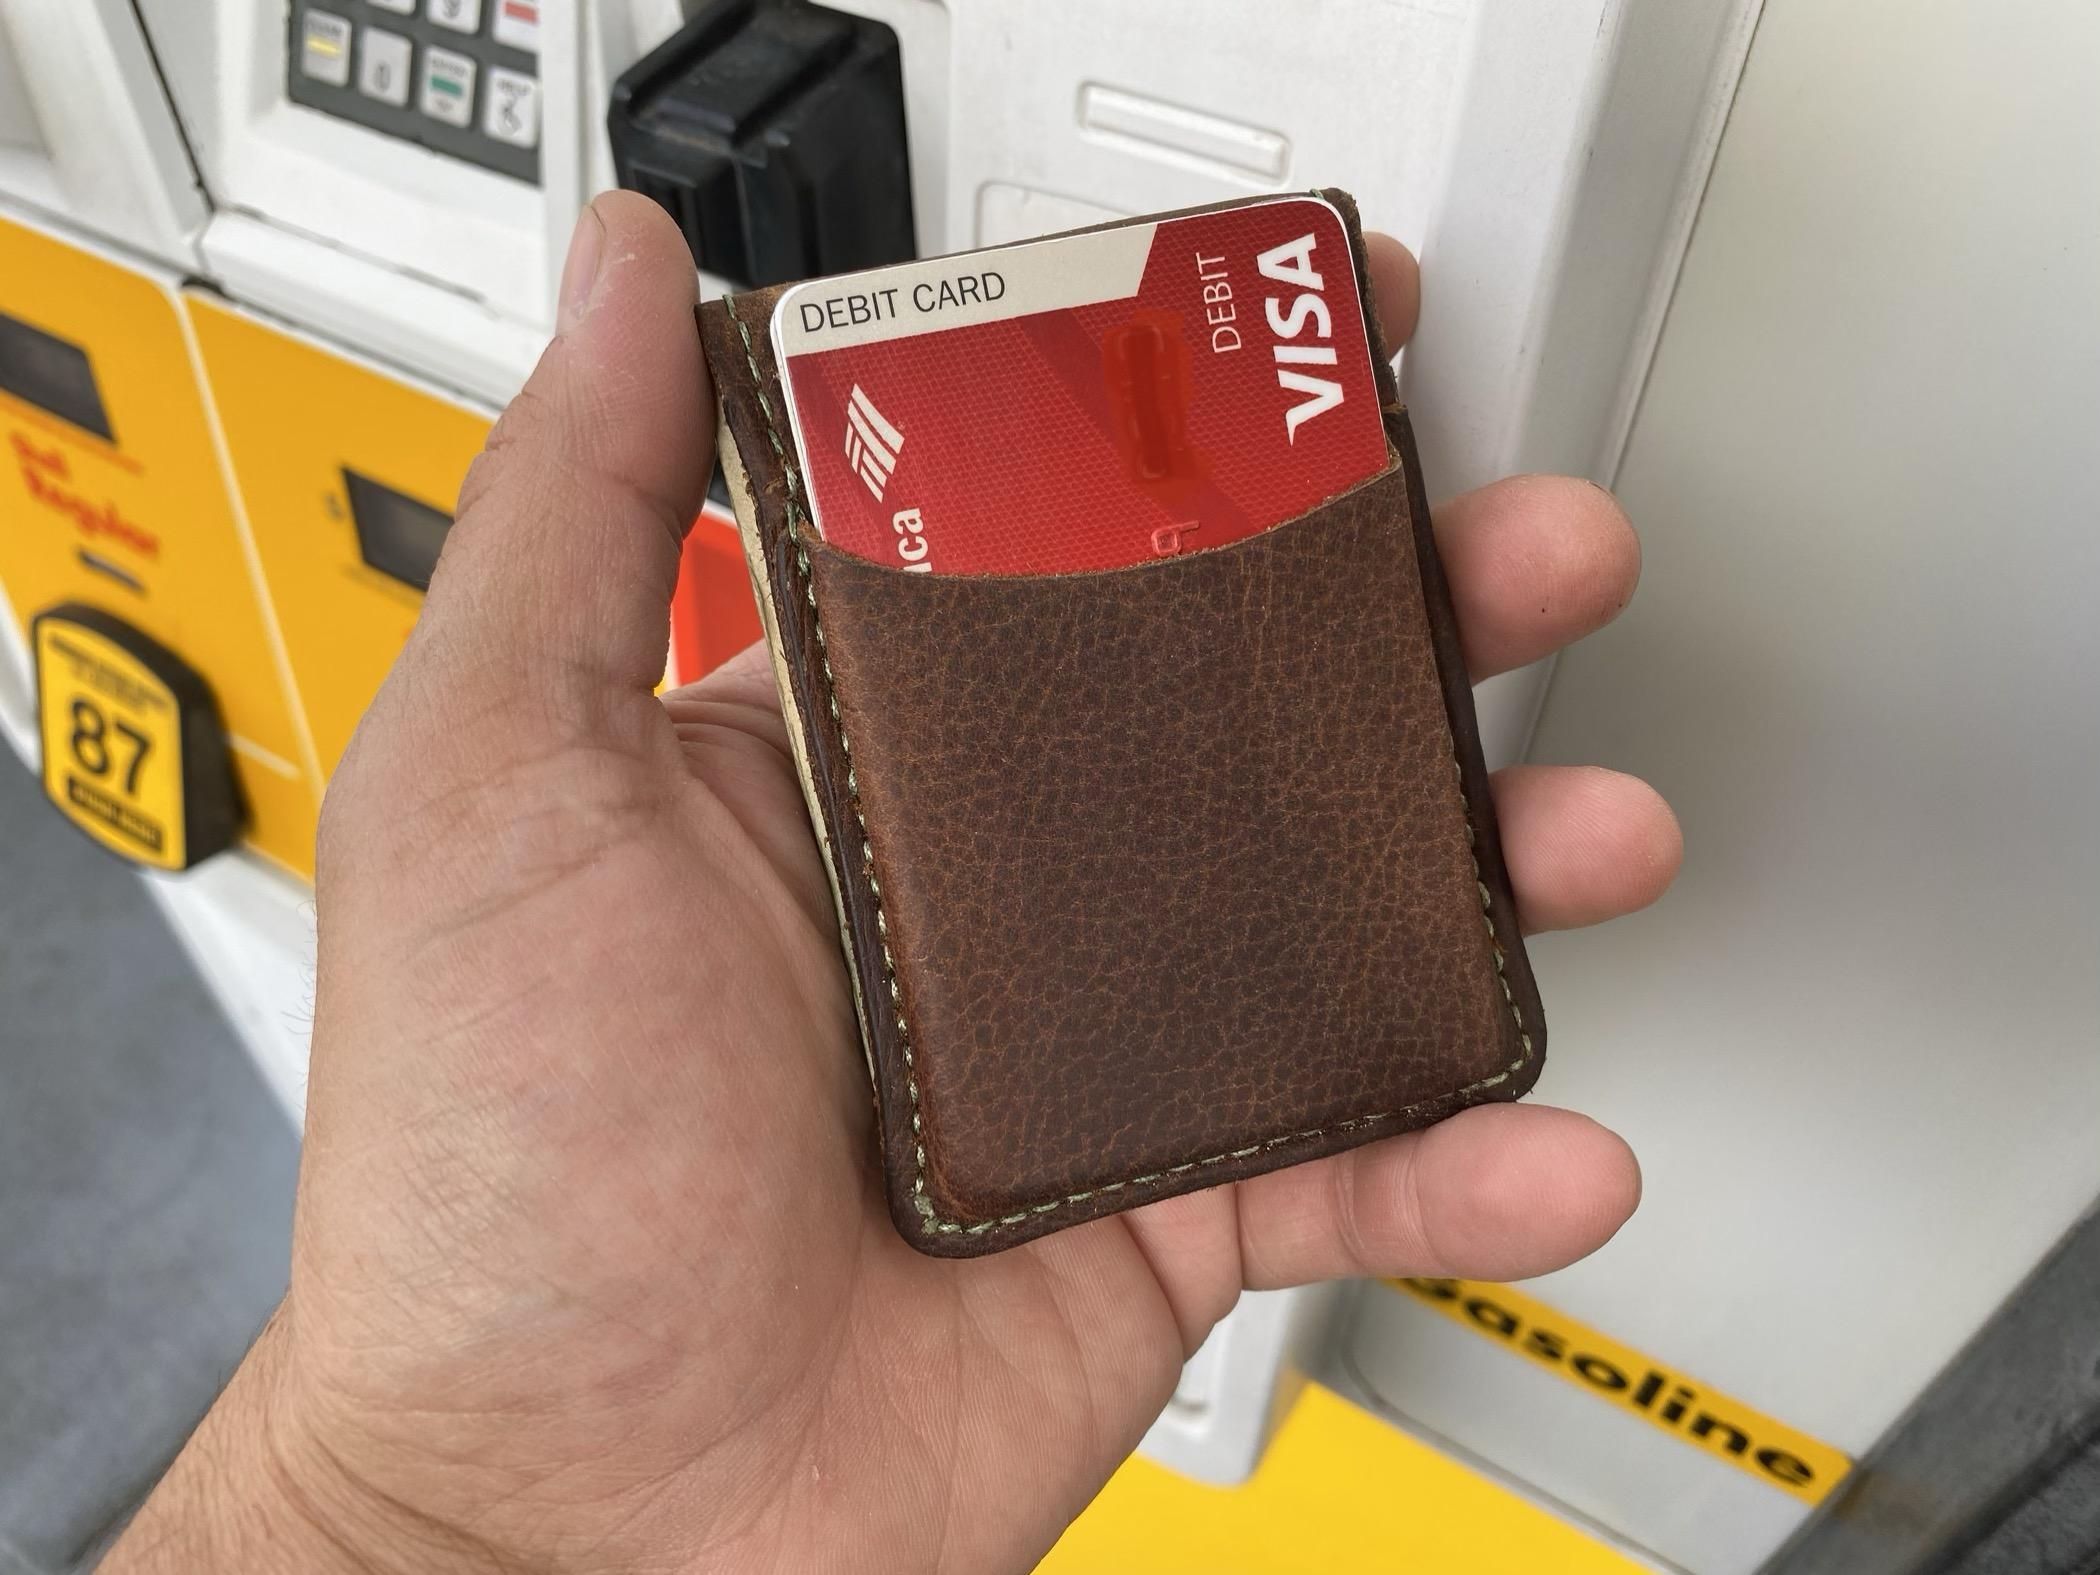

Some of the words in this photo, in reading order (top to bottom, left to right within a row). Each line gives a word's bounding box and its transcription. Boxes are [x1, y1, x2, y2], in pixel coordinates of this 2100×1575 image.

[800, 288, 898, 333] DEBIT
[913, 272, 1005, 313] CARD
[1195, 252, 1242, 353] DEBIT
[1256, 232, 1345, 448] VISA
[70, 697, 152, 796] 87
